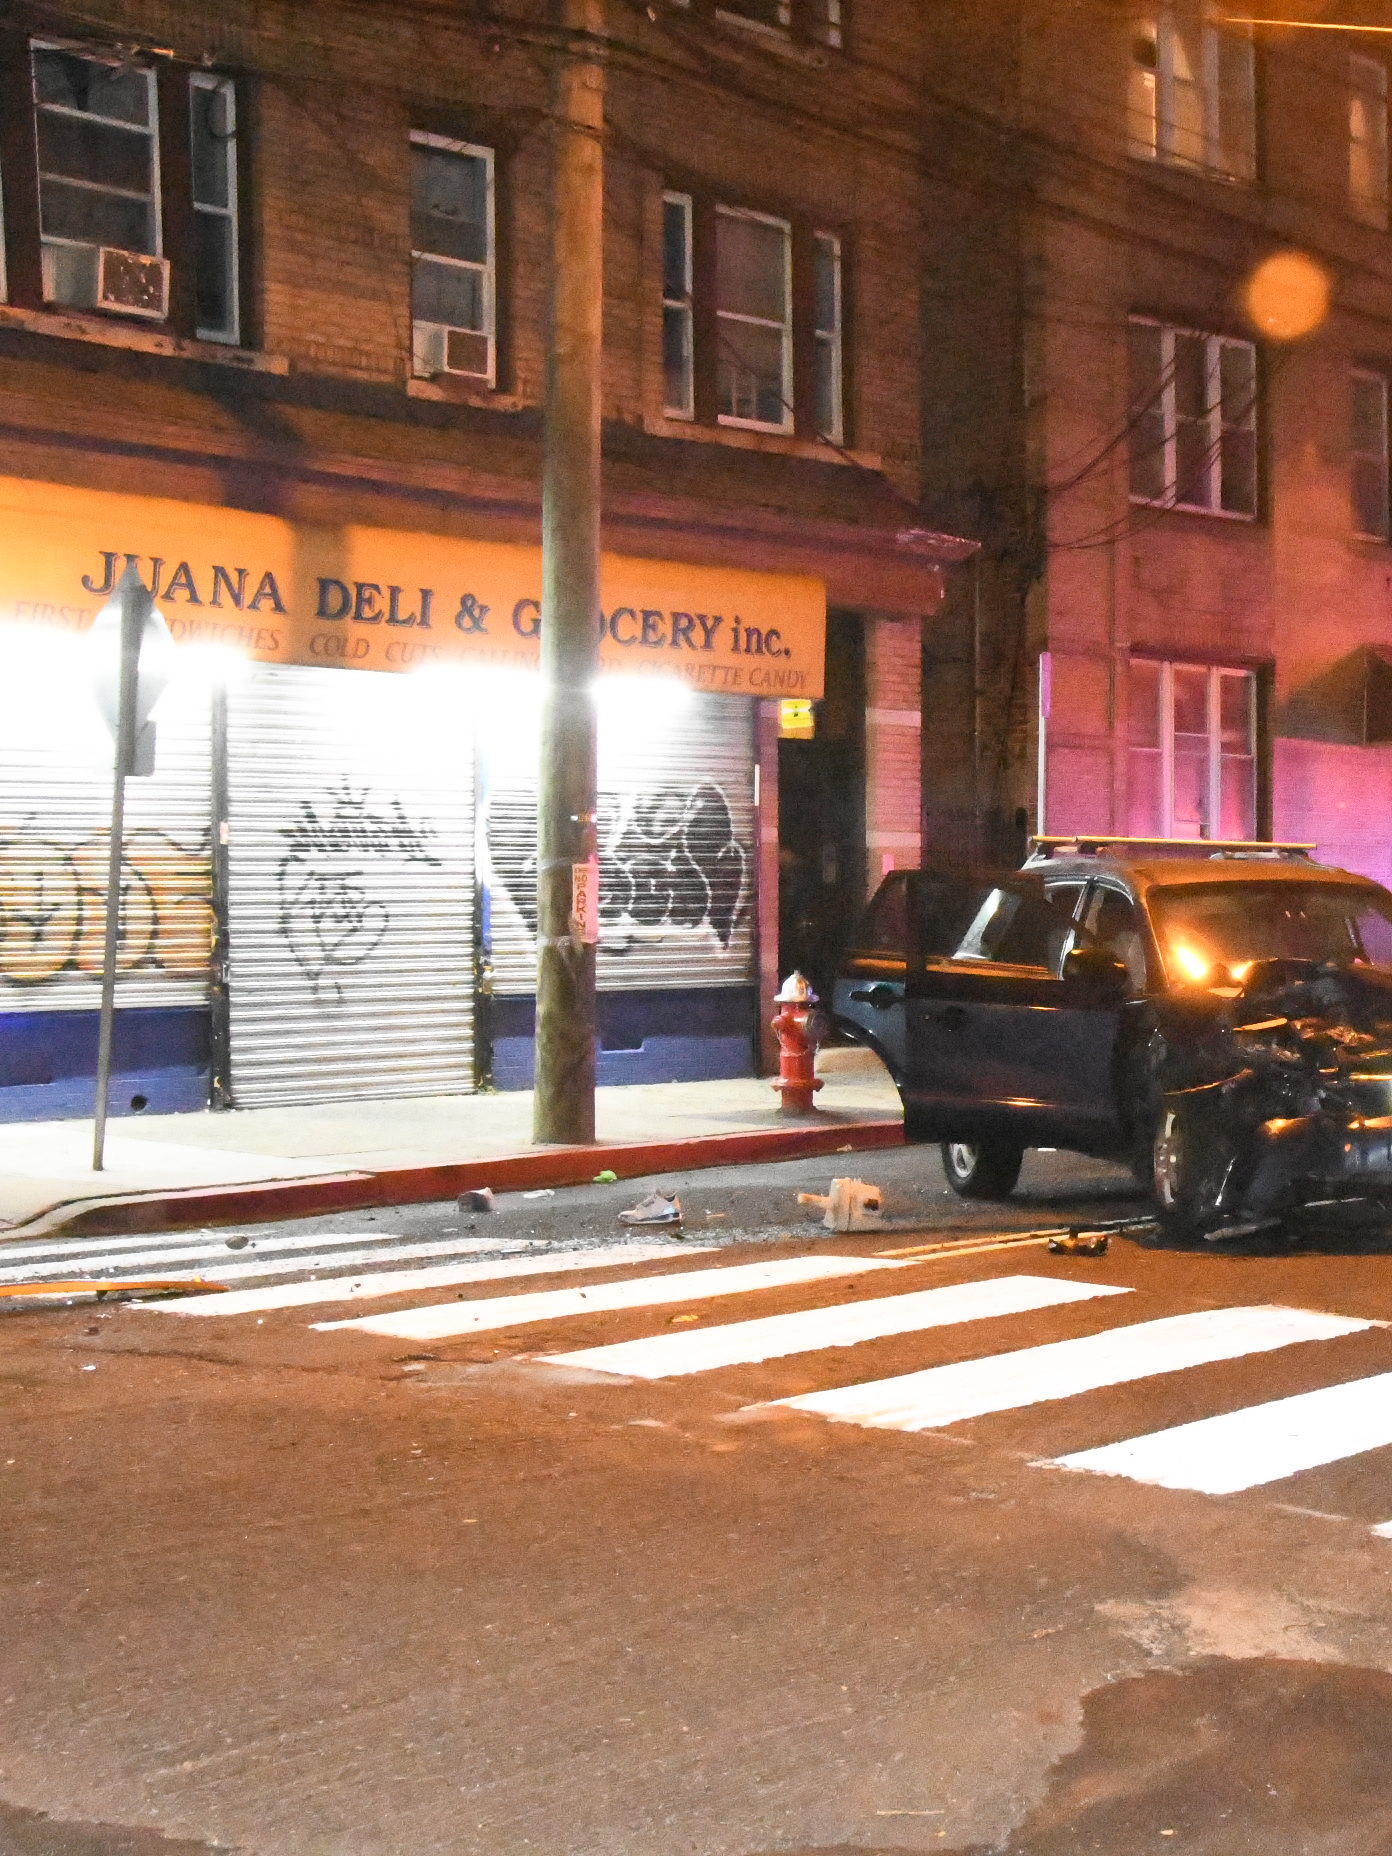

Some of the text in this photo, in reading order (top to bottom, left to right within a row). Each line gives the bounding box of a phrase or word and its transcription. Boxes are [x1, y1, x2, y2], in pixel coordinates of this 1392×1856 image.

[81, 550, 792, 658] JUANA DELI & GCERY inc.
[309, 632, 371, 660] COLD
[750, 667, 809, 689] CANDY
